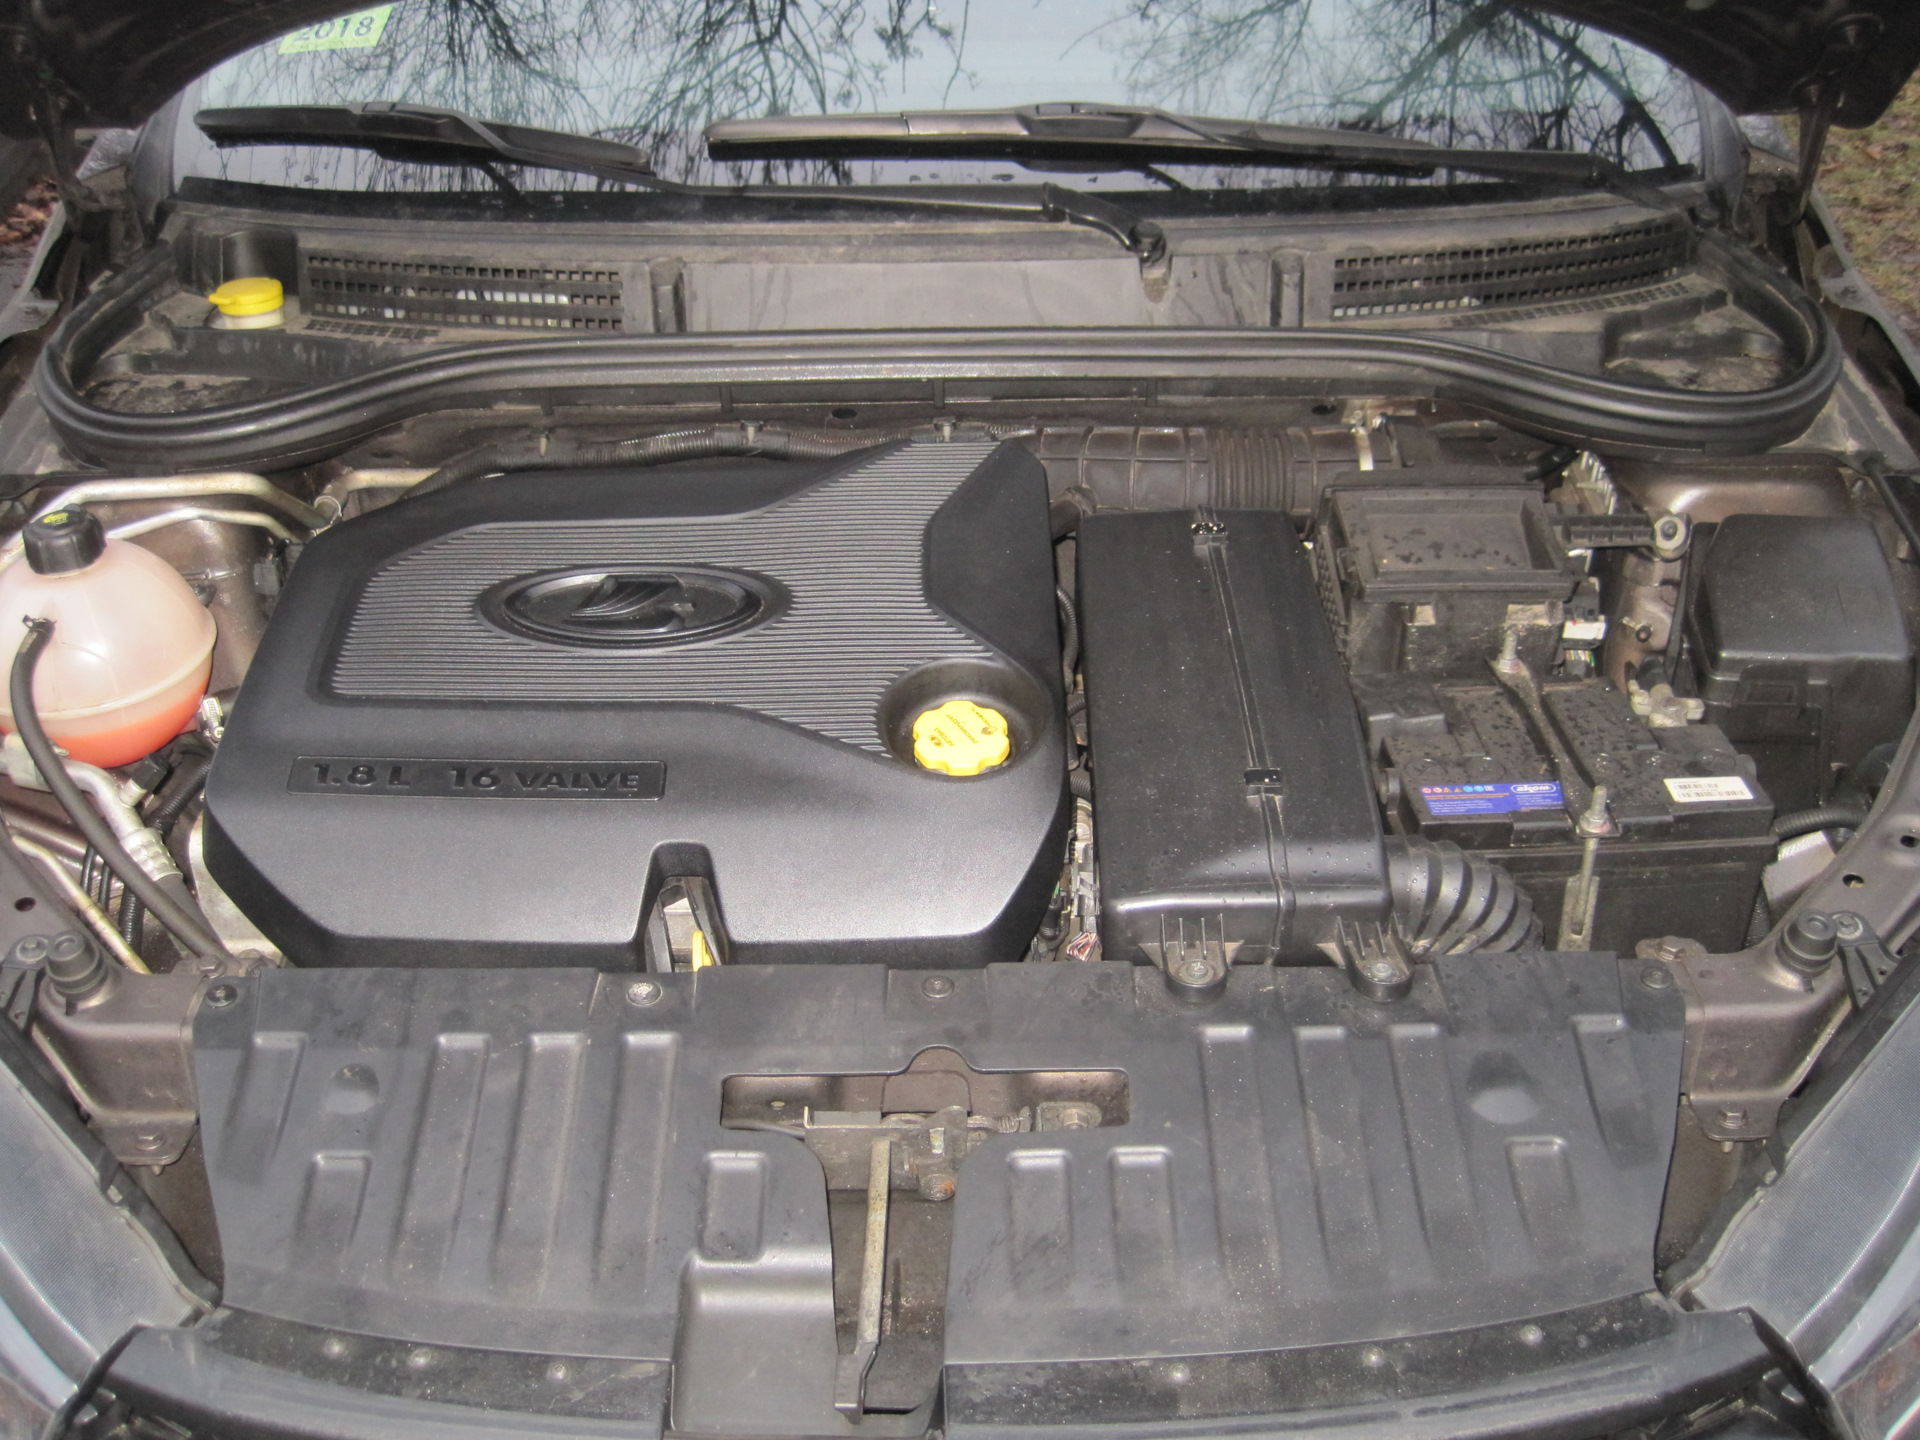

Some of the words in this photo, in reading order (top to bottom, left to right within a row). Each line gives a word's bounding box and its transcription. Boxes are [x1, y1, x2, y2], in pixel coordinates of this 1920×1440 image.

[314, 763, 377, 787] 1.8
[450, 767, 500, 790] 16
[515, 771, 639, 791] VALVE
